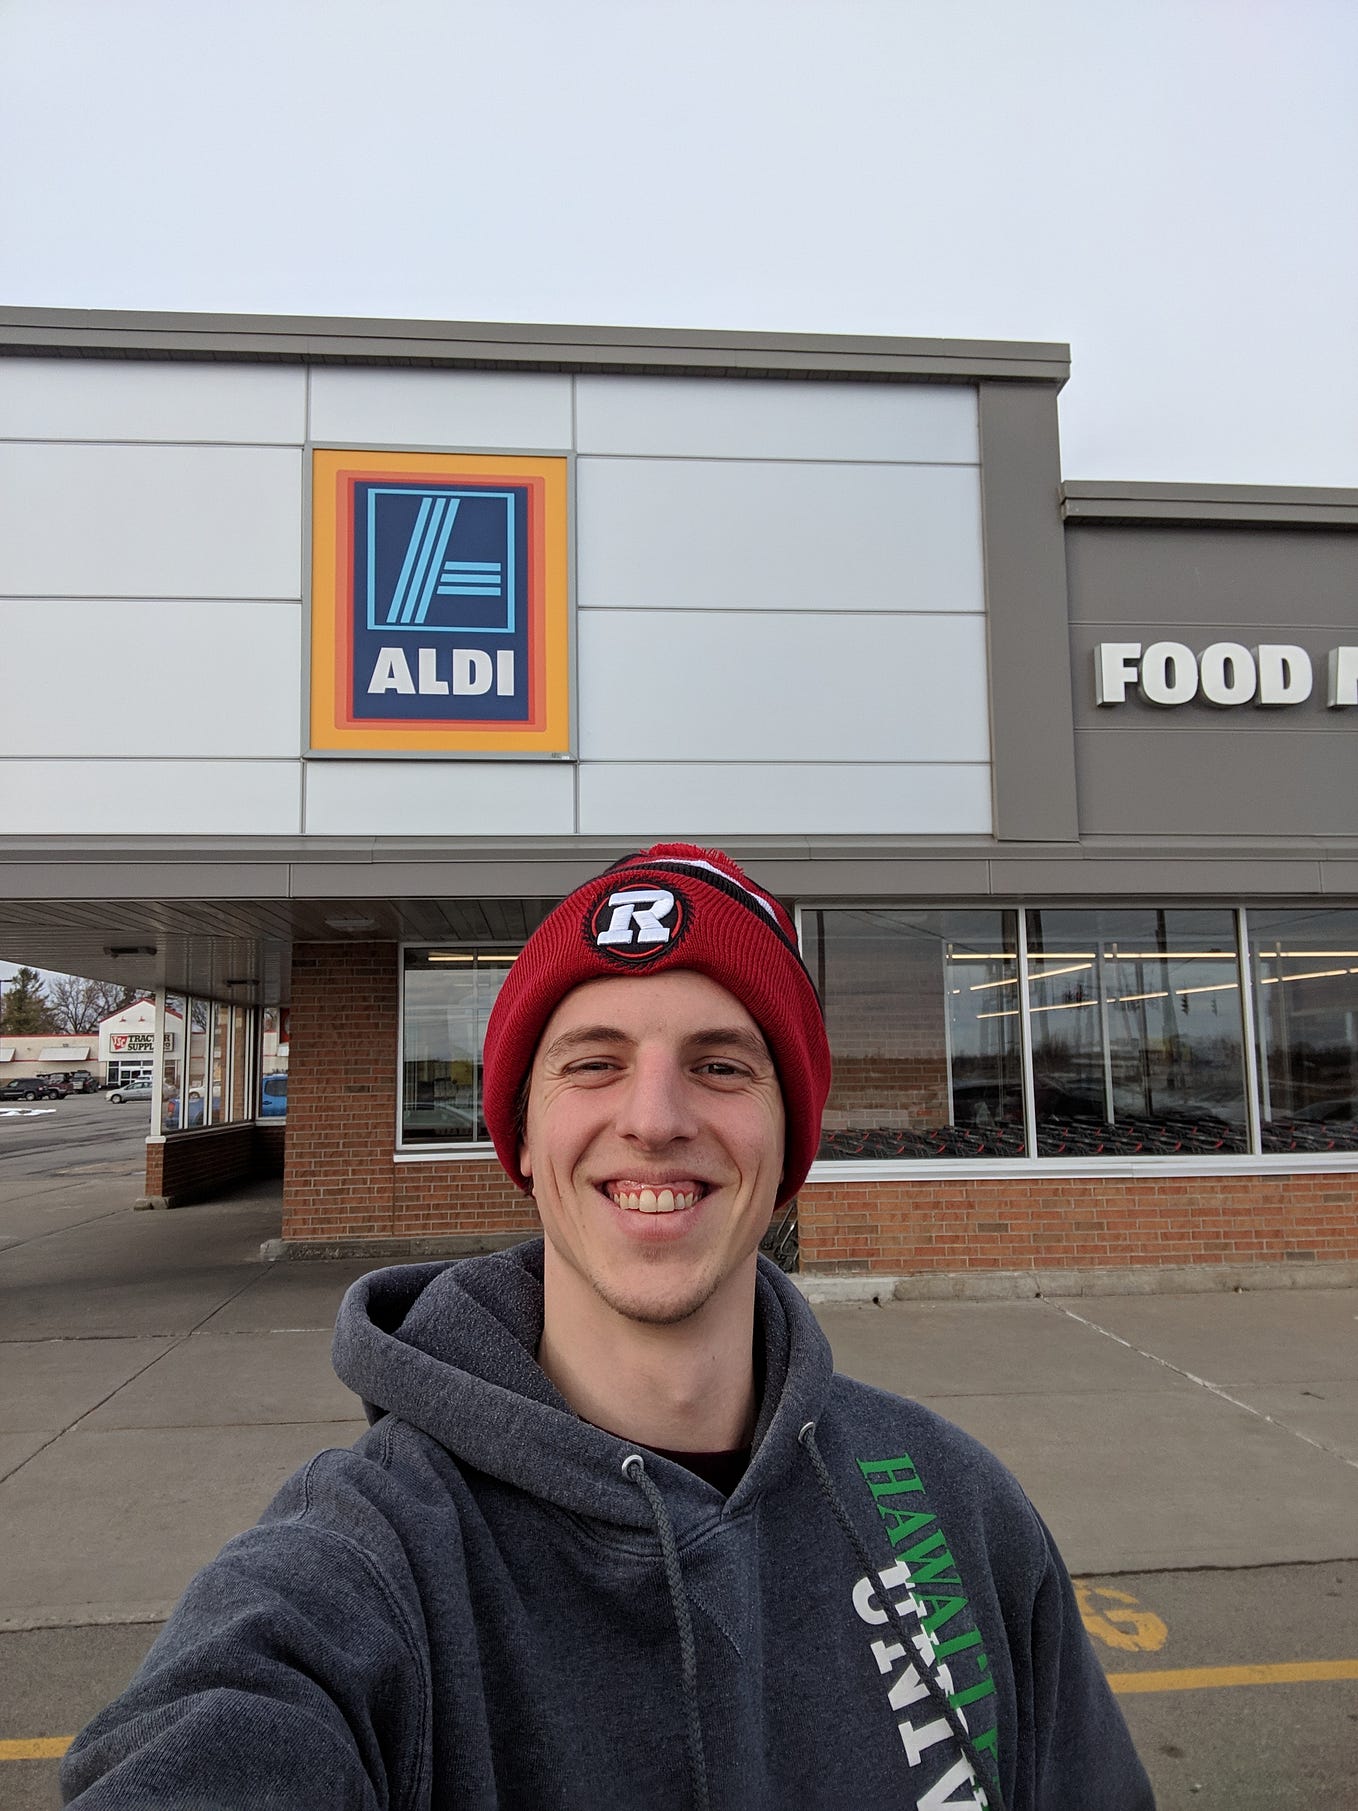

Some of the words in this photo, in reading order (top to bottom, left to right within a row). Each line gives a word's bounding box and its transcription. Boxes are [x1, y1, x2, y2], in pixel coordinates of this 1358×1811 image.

[367, 647, 515, 696] ALDI
[1095, 641, 1313, 706] FOOD
[597, 889, 675, 946] R
